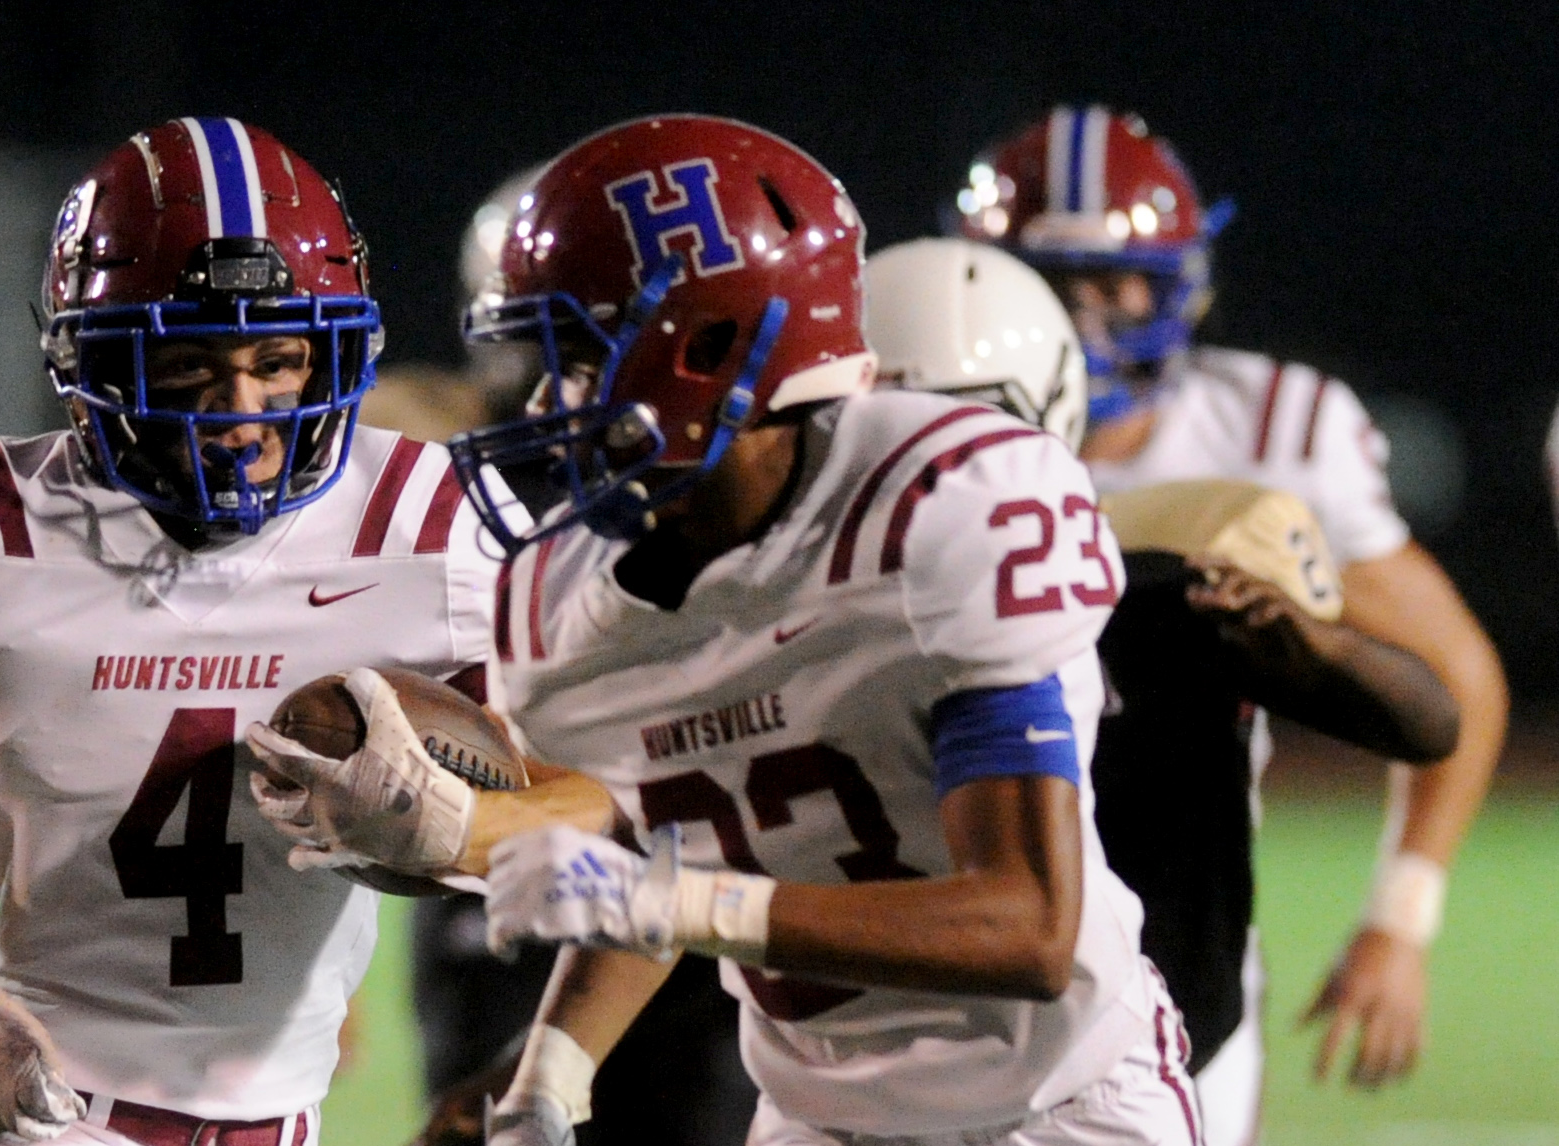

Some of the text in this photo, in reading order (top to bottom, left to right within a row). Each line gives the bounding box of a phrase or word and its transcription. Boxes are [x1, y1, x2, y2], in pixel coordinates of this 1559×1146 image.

[604, 156, 746, 301] H
[987, 494, 1117, 619] 23
[92, 654, 285, 691] HUNTSVILLE
[641, 694, 786, 762] HUNTSVILLE
[109, 707, 244, 987] 4
